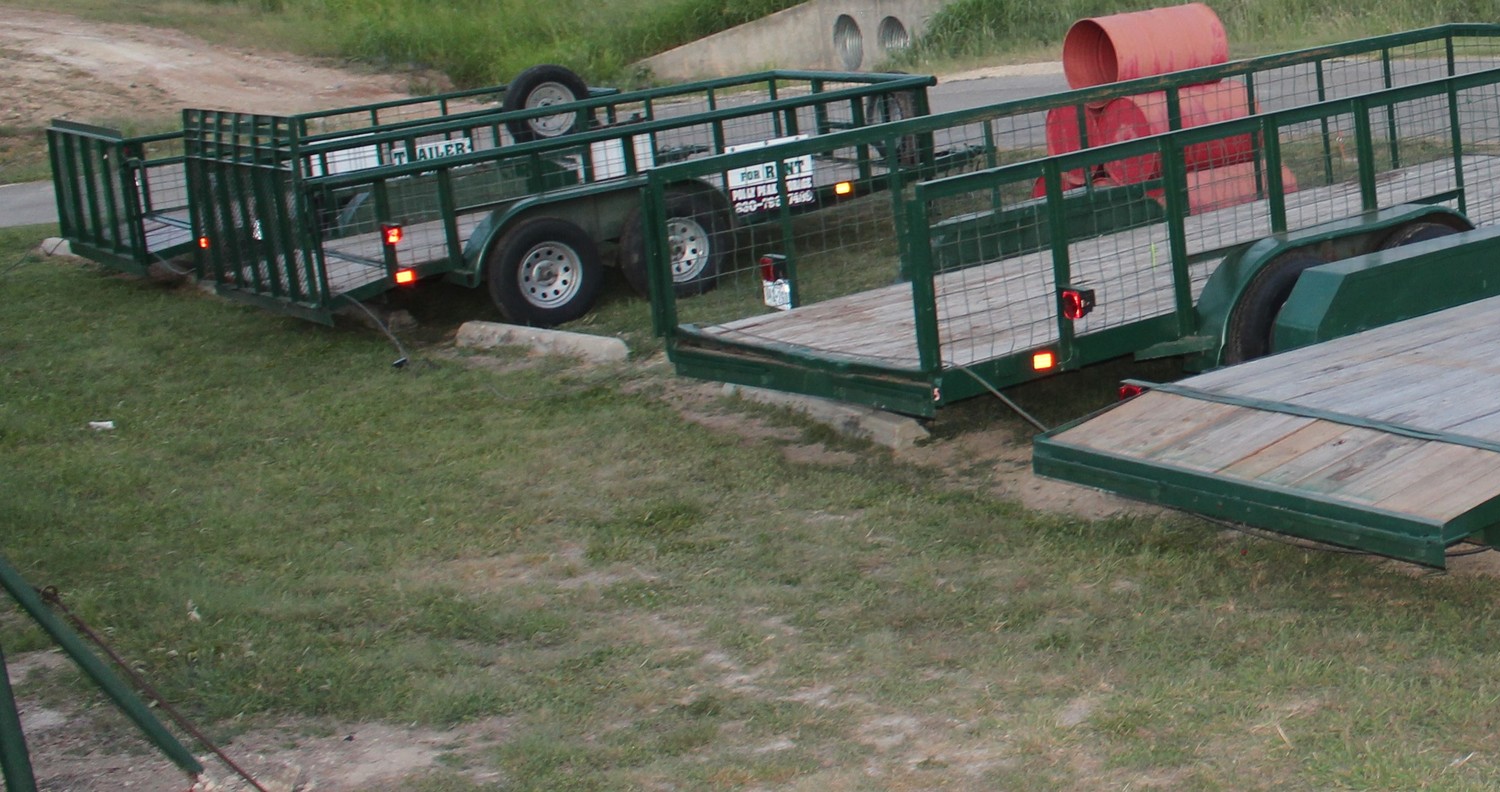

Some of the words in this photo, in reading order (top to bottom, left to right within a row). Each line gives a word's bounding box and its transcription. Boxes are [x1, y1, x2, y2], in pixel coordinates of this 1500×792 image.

[394, 143, 465, 165] TAILER
[740, 170, 760, 182] FOR
[765, 160, 804, 179] RNT
